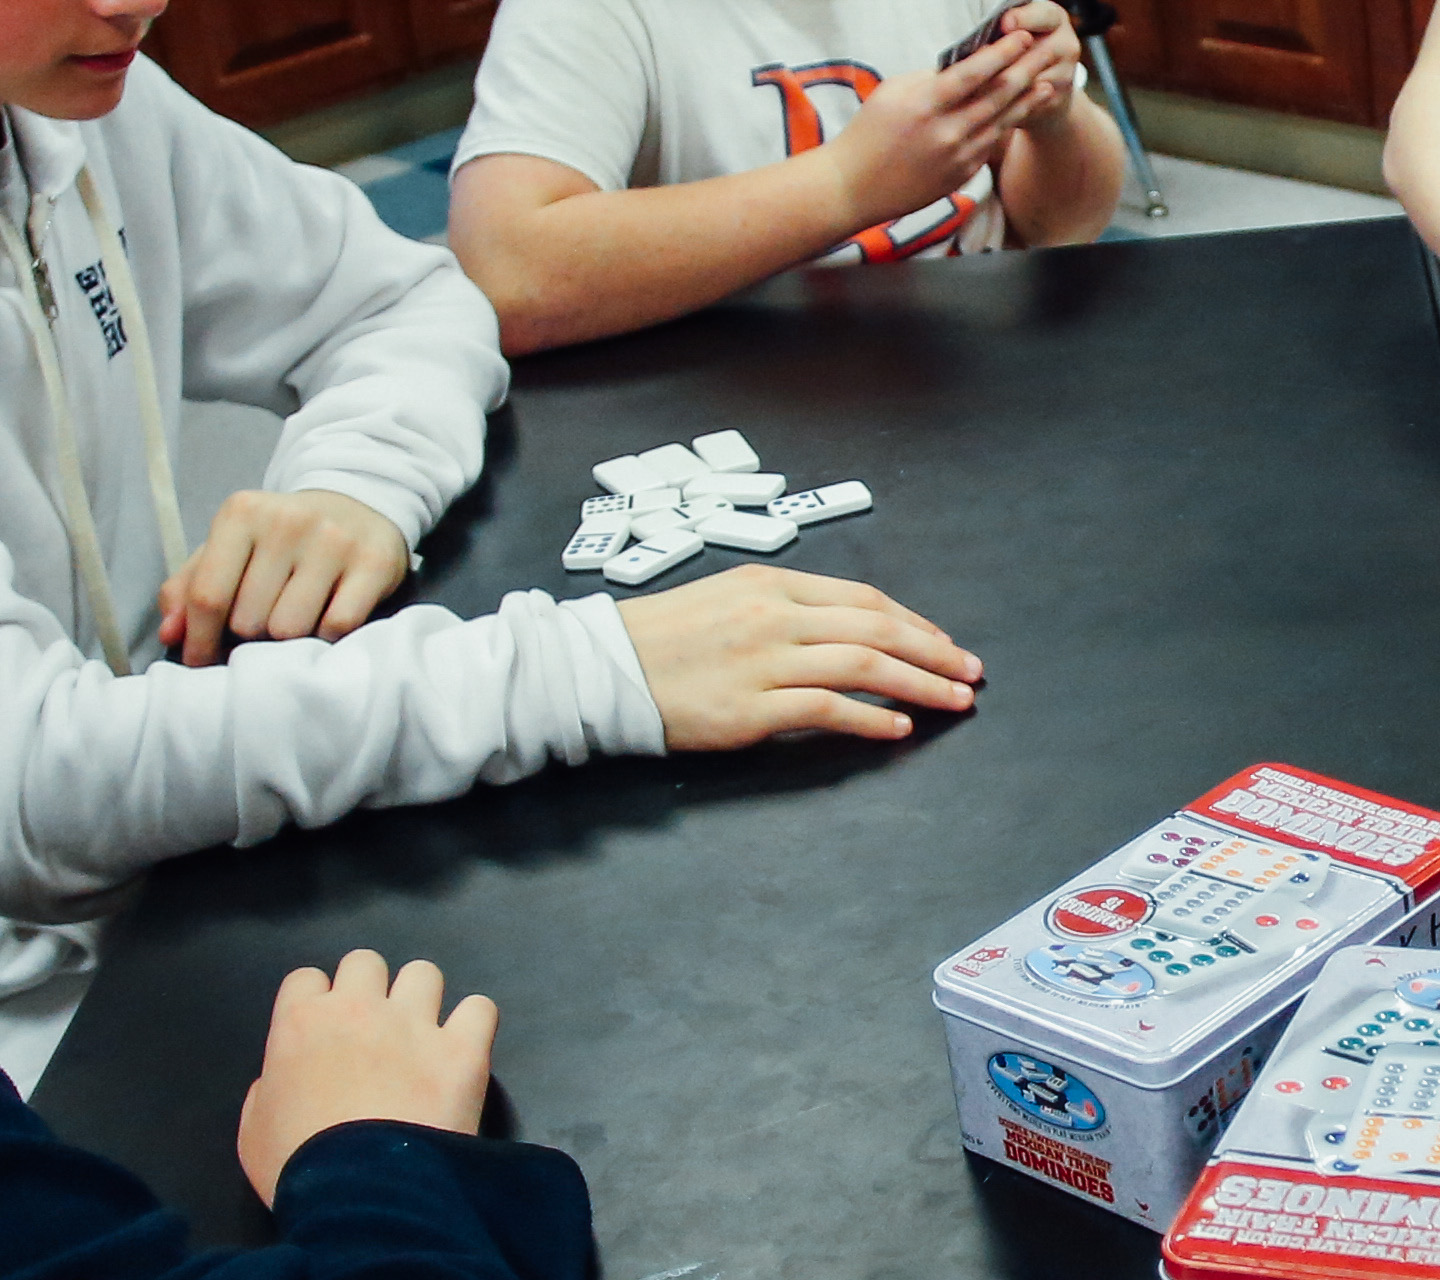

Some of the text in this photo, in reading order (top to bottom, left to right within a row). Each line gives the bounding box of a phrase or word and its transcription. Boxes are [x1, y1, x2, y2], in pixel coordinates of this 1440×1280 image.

[1209, 788, 1426, 866] DOMINOES
[1248, 780, 1439, 845] MEXICAN TRAIN
[1059, 898, 1134, 931] DOMINOES
[1002, 1139, 1115, 1204] DOMINOES
[1005, 1127, 1108, 1181] MEXICAN TRAIN
[1213, 1208, 1319, 1237] TRAIN
